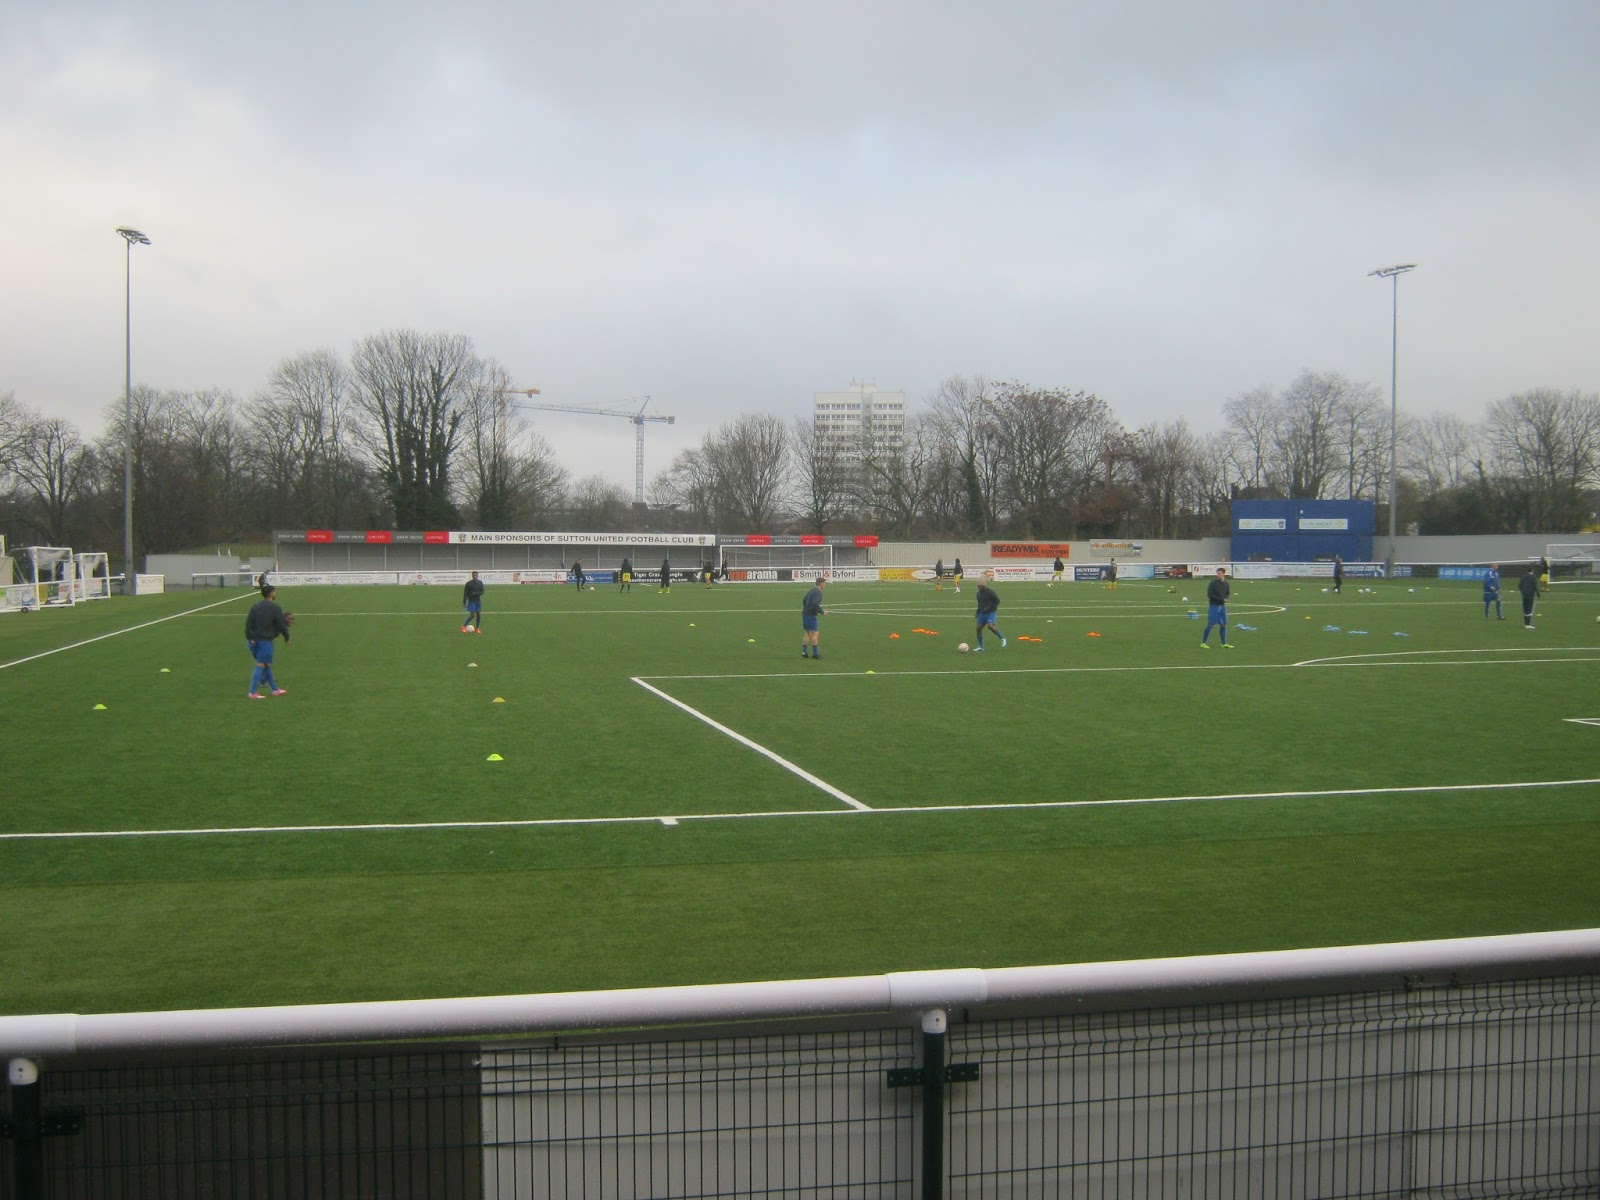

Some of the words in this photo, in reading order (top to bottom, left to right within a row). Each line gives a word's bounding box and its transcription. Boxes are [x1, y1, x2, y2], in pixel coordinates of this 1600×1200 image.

[281, 574, 300, 582] Smith
[730, 570, 777, 581] vanarama
[800, 570, 822, 579] Smith
[824, 570, 830, 579] &
[832, 570, 856, 579] Byford
